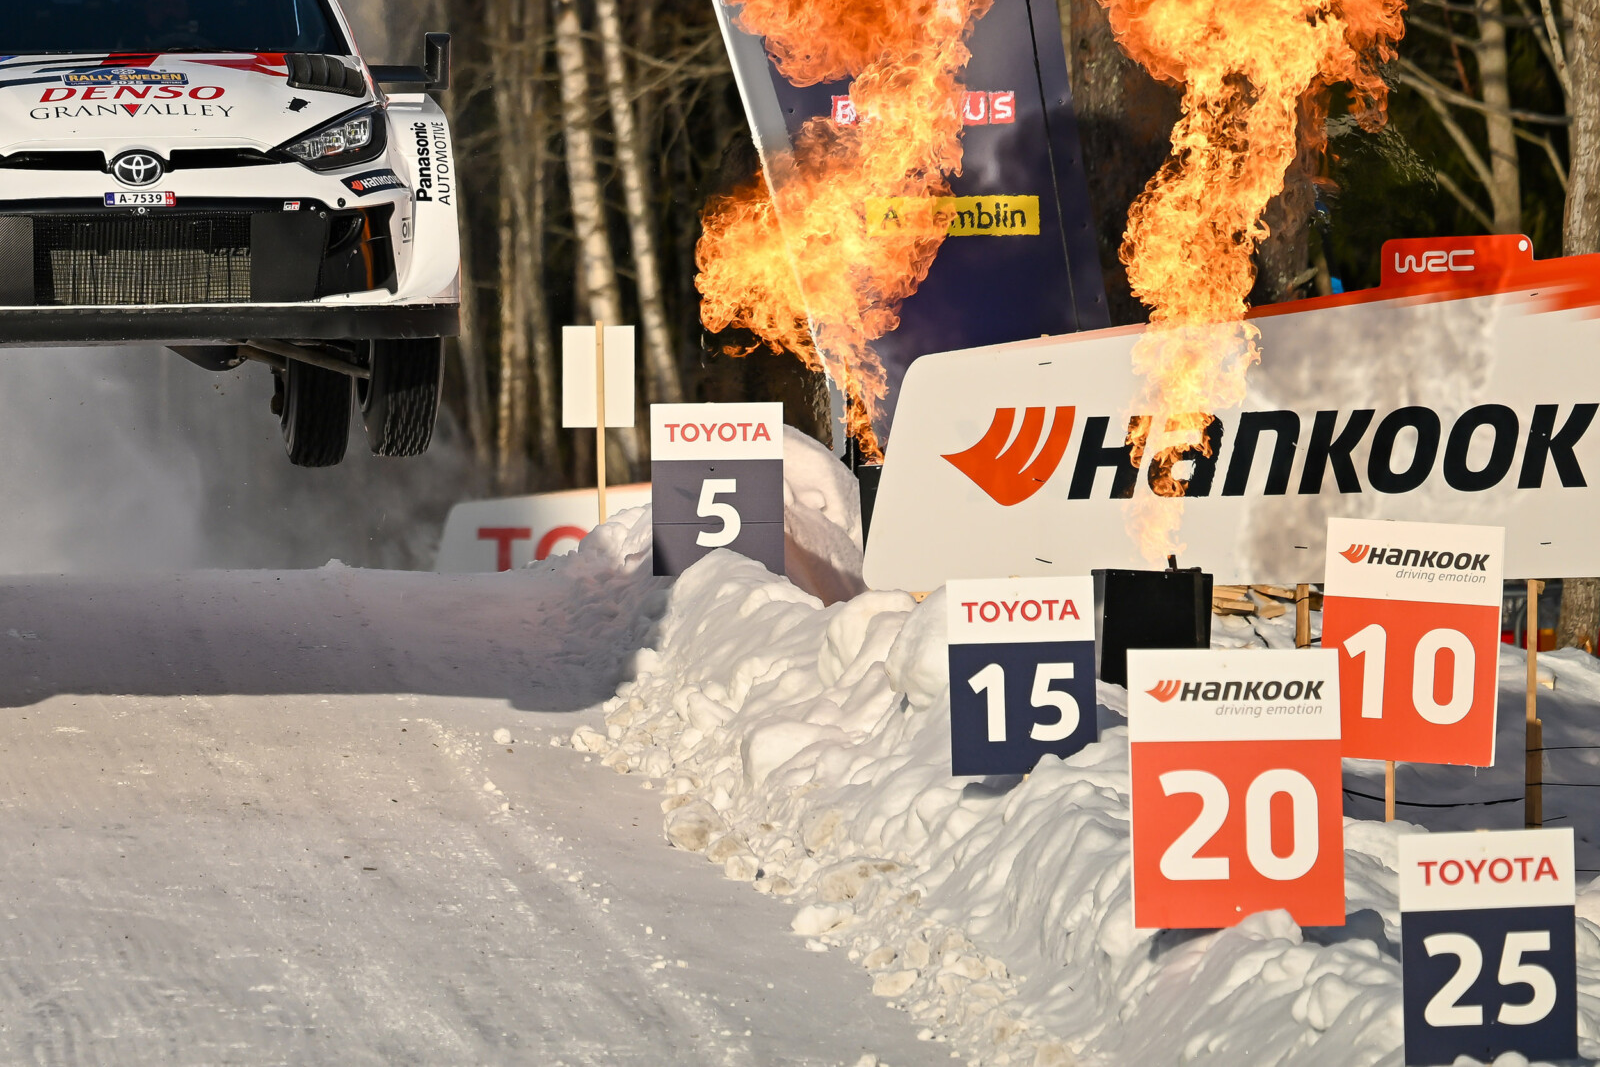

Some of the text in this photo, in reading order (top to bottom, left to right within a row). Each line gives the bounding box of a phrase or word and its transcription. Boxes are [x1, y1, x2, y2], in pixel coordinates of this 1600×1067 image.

[68, 73, 182, 82] RALLY SWEDEN
[39, 85, 226, 103] DENSO
[410, 122, 433, 202] Panasonic
[431, 121, 451, 206] AUTOMOTIVE
[119, 193, 163, 204] A-7539
[664, 422, 771, 443] TOYOTA
[695, 478, 741, 548] 5
[1395, 569, 1486, 584] driving emotion
[961, 599, 1081, 623] TOYOTA
[1342, 622, 1477, 726] 10
[967, 662, 1081, 742] 15
[1215, 703, 1323, 718] driving emotion
[1158, 768, 1320, 882] 20
[1417, 857, 1559, 886] TOYOTA
[1423, 930, 1557, 1027] 25
